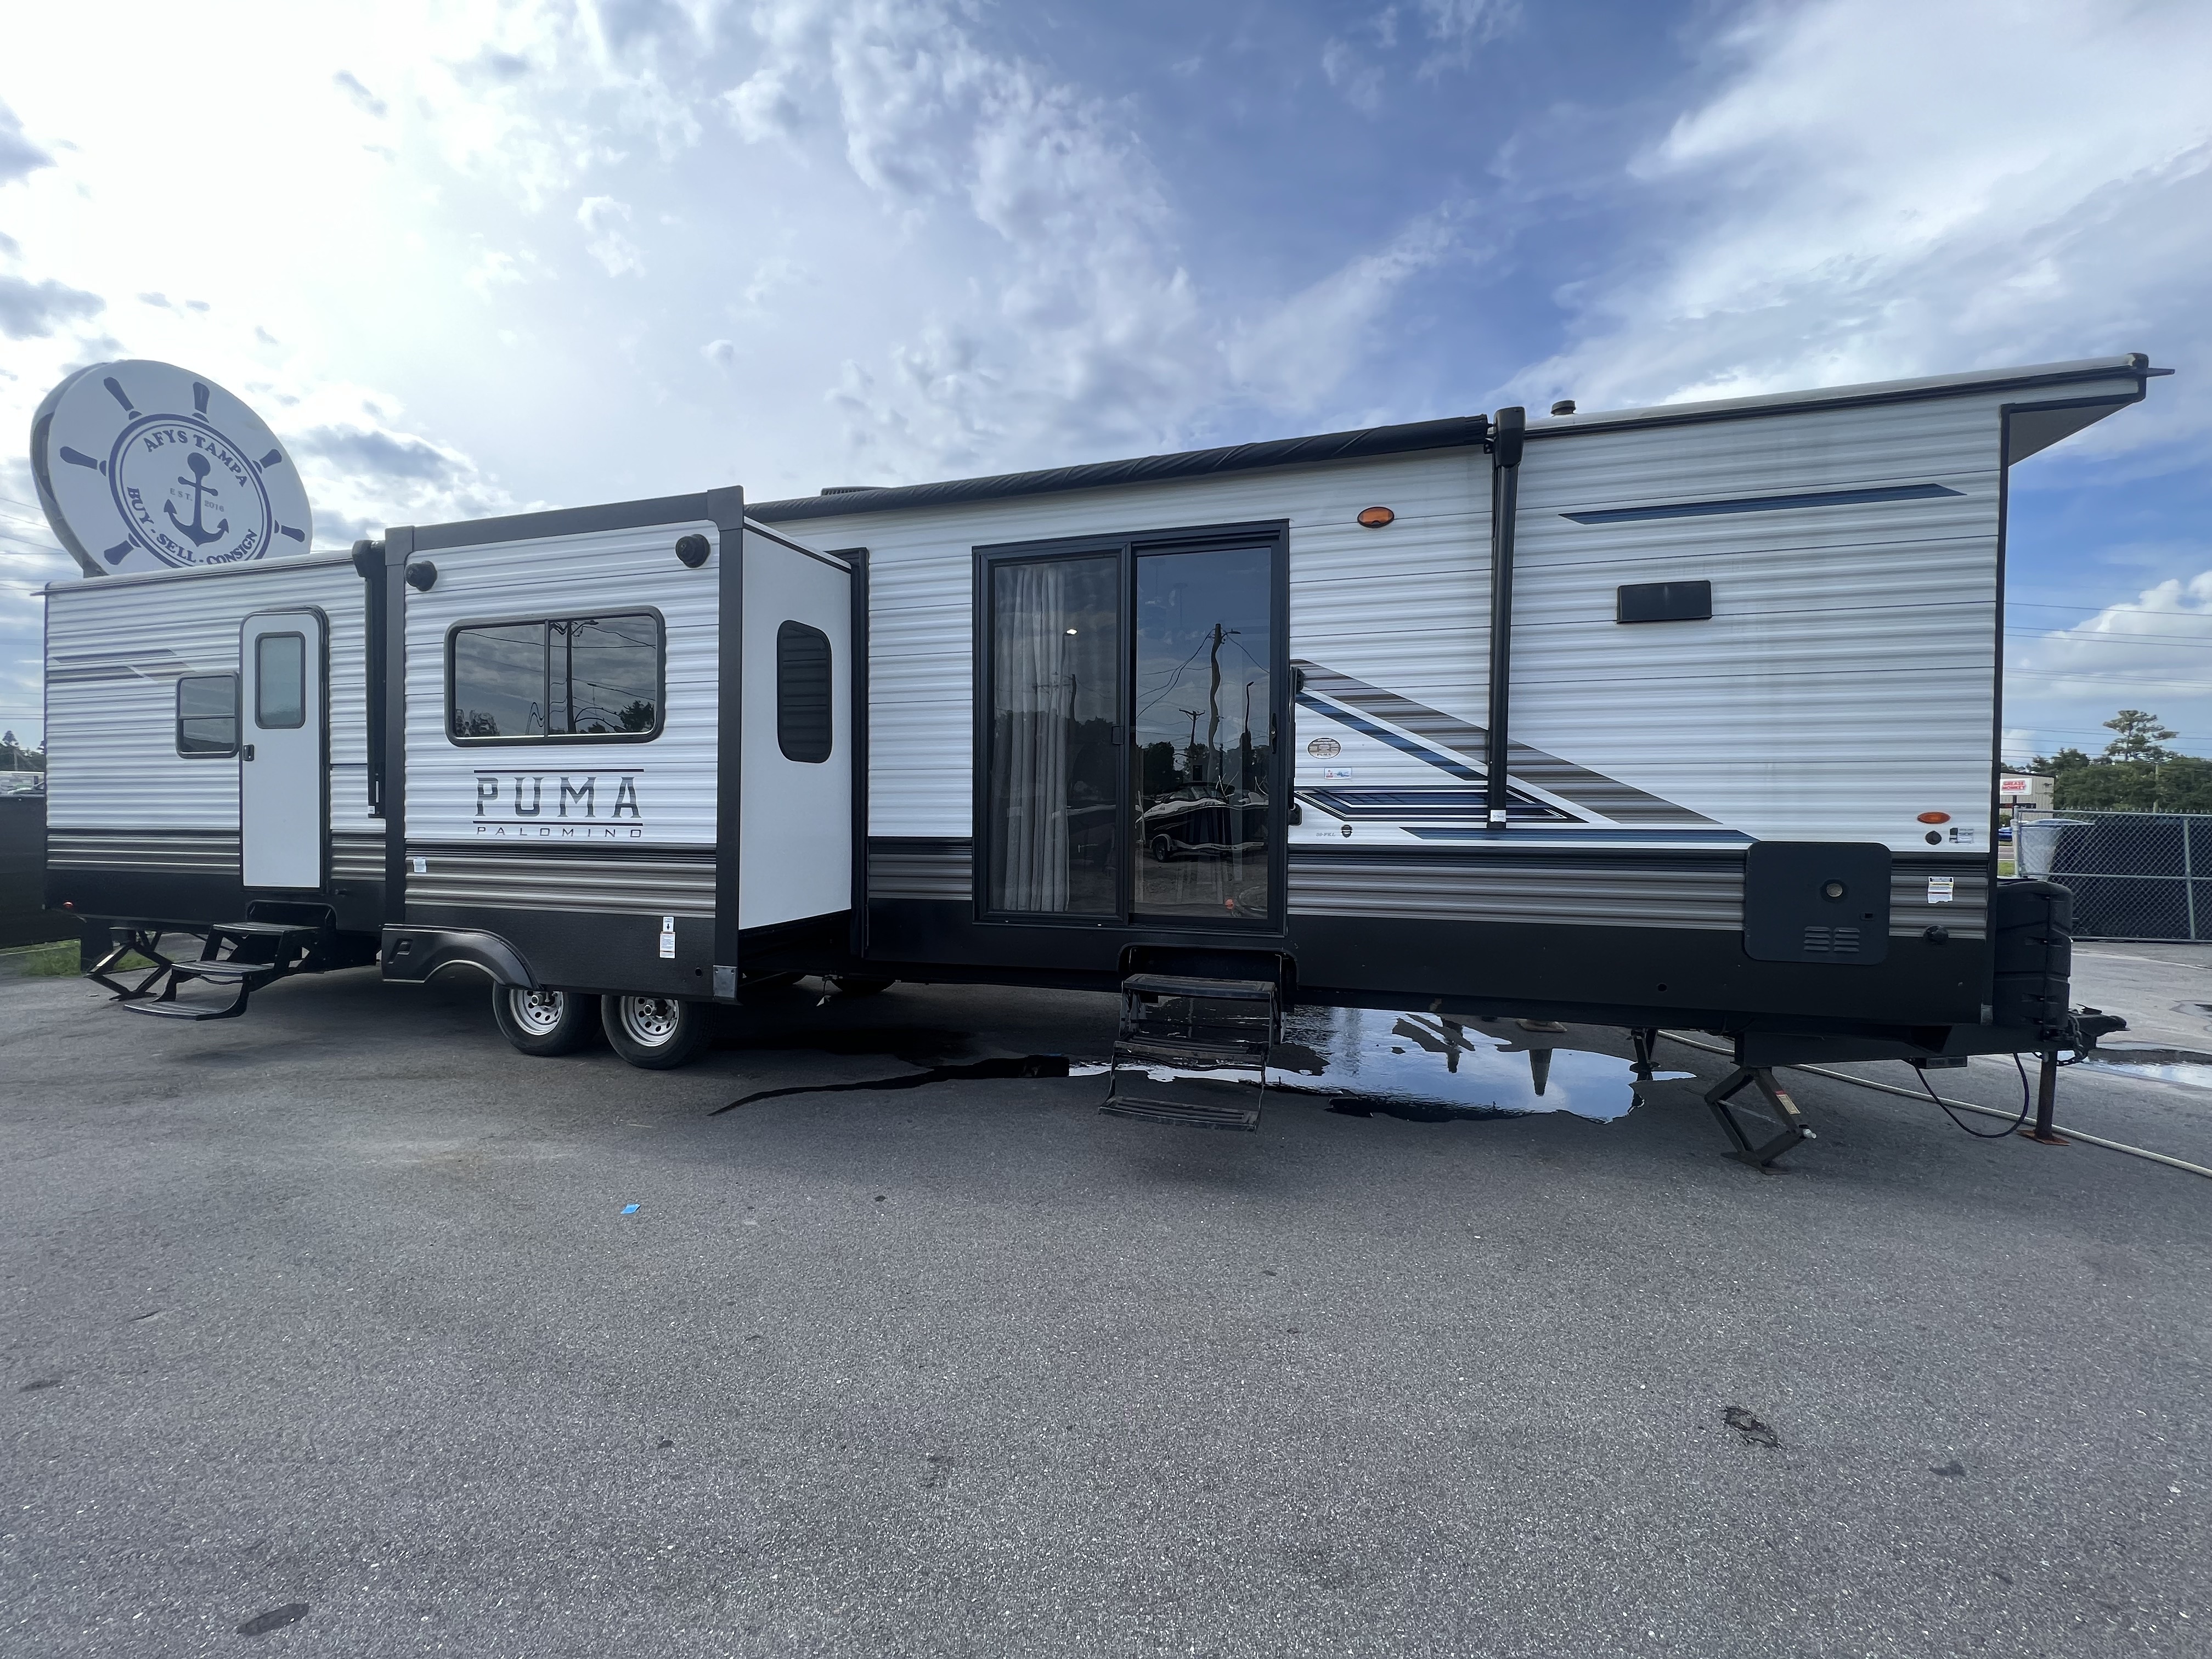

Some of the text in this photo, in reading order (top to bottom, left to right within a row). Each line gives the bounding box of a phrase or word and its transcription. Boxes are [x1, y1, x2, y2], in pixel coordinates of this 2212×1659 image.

[143, 430, 247, 487] AFYS TAMPA
[170, 488, 193, 501] EST.
[127, 487, 257, 565] BUY SELL CONSIGN
[475, 776, 642, 819] PUMA
[476, 826, 642, 838] PALOMINO
